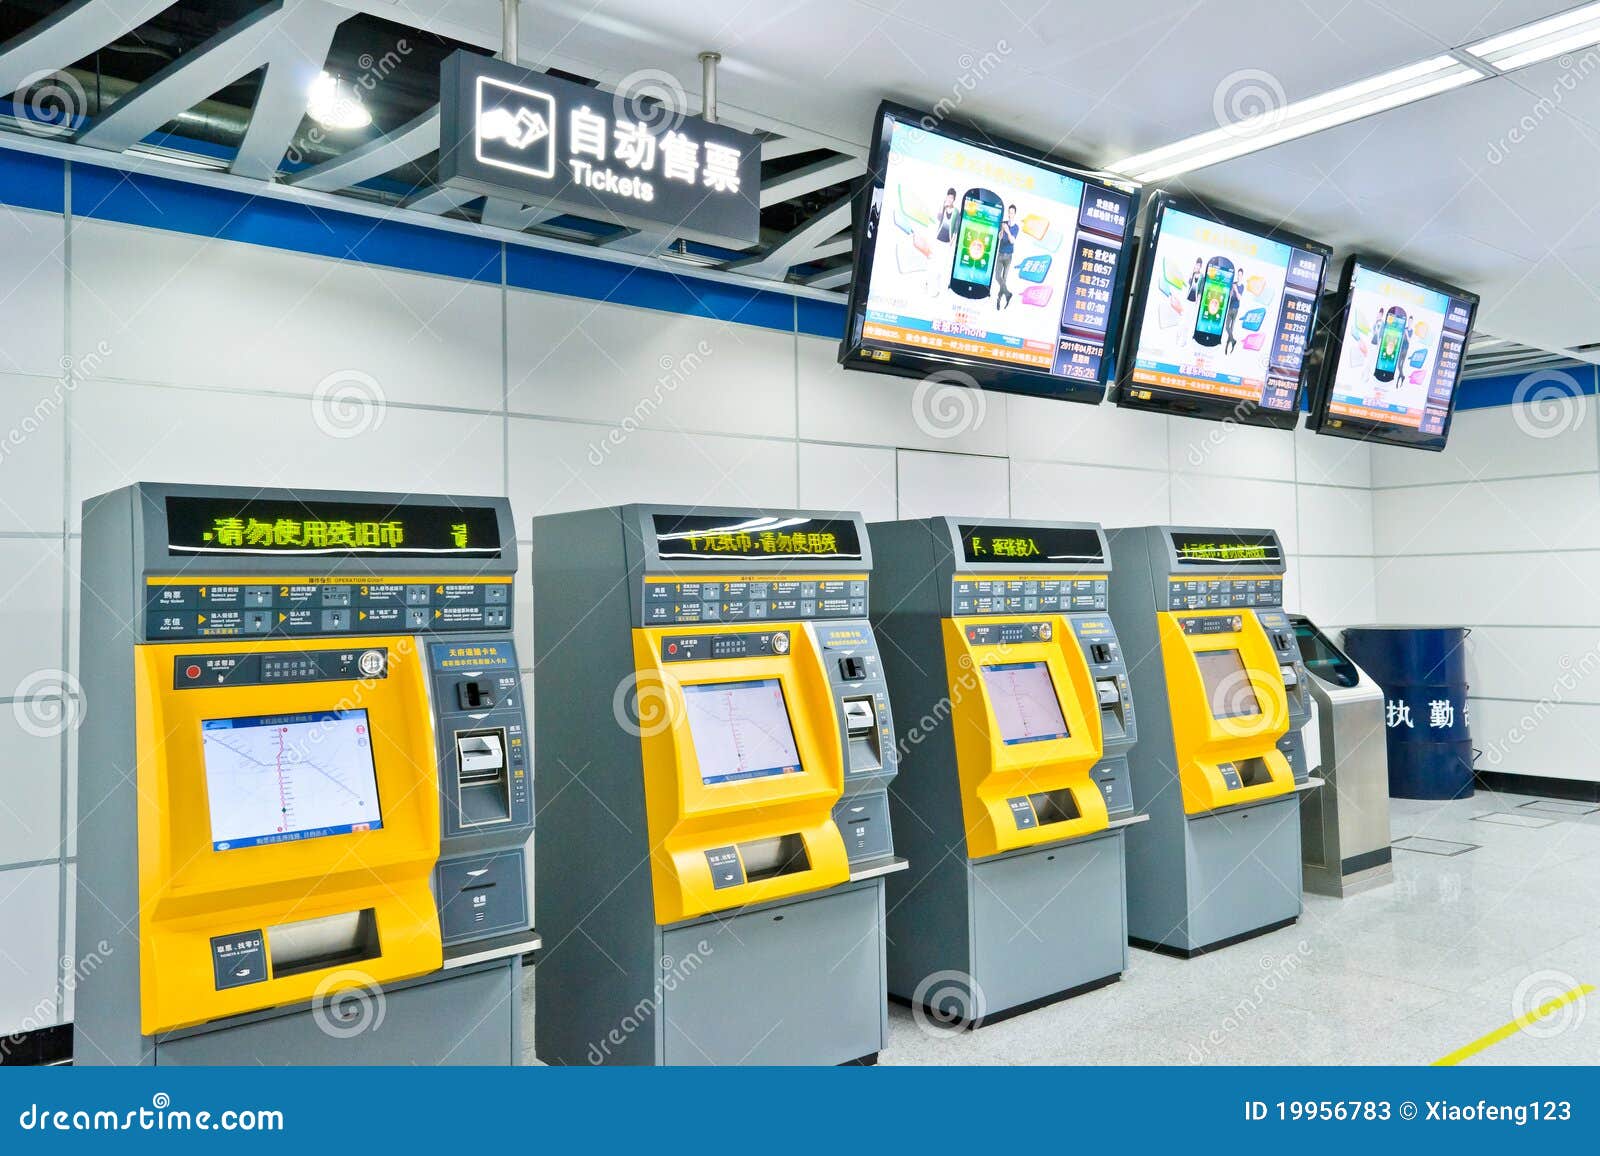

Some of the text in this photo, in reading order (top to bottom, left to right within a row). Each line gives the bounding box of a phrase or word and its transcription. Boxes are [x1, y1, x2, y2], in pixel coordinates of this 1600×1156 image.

[569, 105, 742, 194] 自动售票
[569, 160, 654, 202] Tickets
[1091, 276, 1110, 289] 21:57
[280, 587, 289, 597] 2
[360, 586, 369, 596] 3
[436, 585, 444, 596] 4
[724, 583, 729, 592] 2
[772, 582, 778, 591] 3
[199, 587, 206, 598] 1
